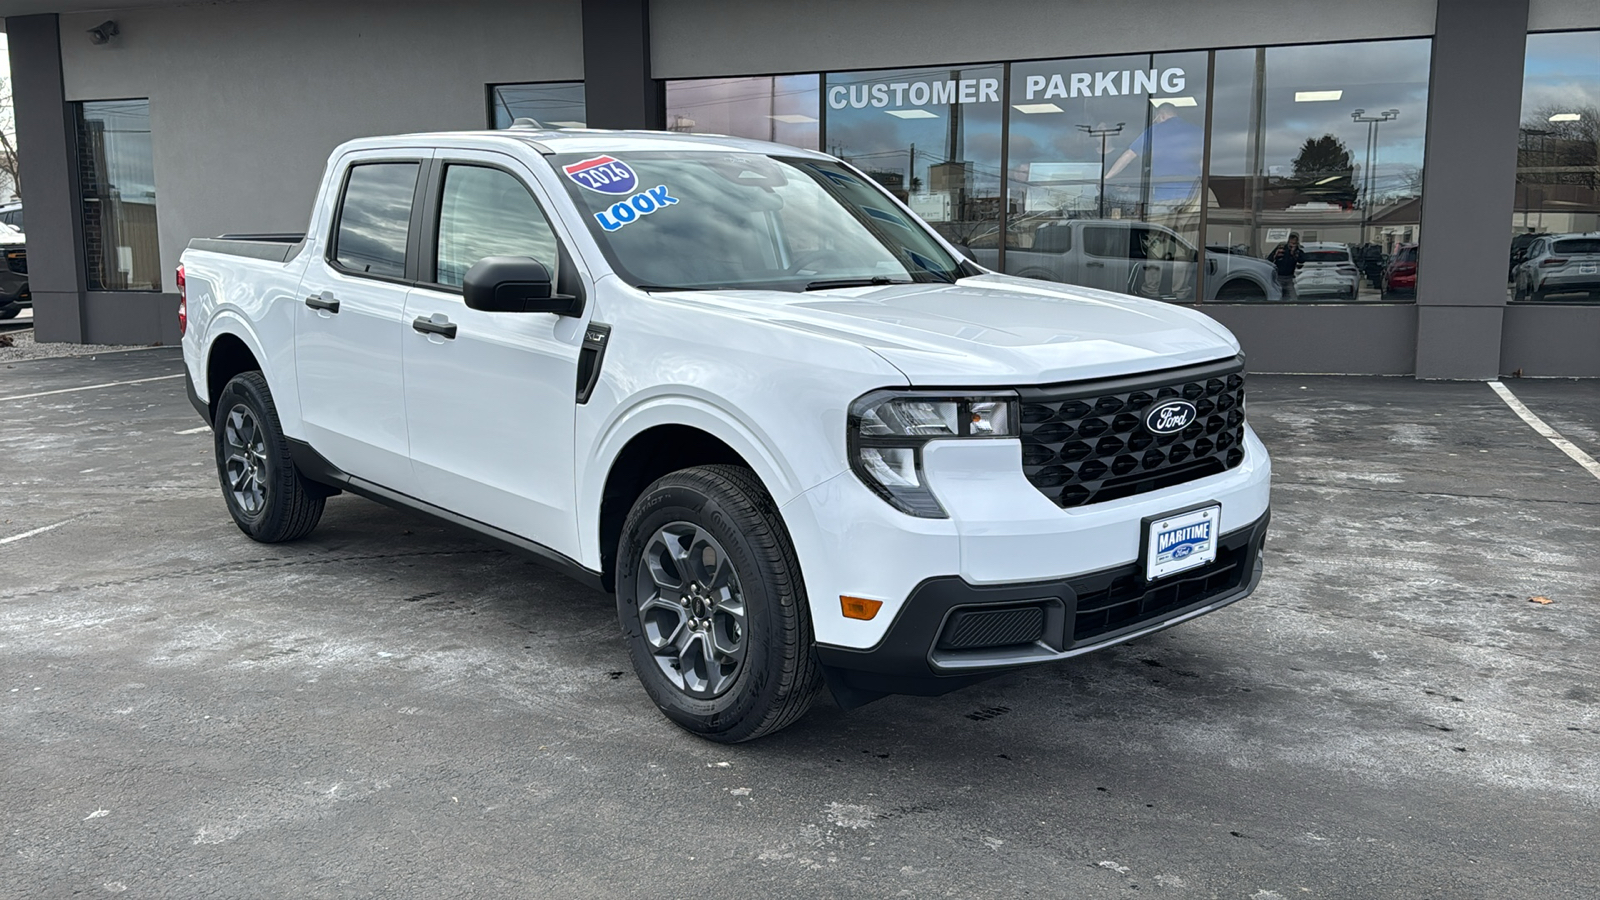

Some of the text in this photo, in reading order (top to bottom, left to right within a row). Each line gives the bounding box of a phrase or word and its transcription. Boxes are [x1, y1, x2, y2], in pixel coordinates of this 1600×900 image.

[828, 67, 1186, 109] CUSTOMER PARKING
[578, 163, 630, 188] 2026
[595, 185, 678, 231] LOOK
[586, 331, 605, 342] XLT
[1156, 406, 1188, 430] Ford
[1159, 523, 1209, 552] MARITIME
